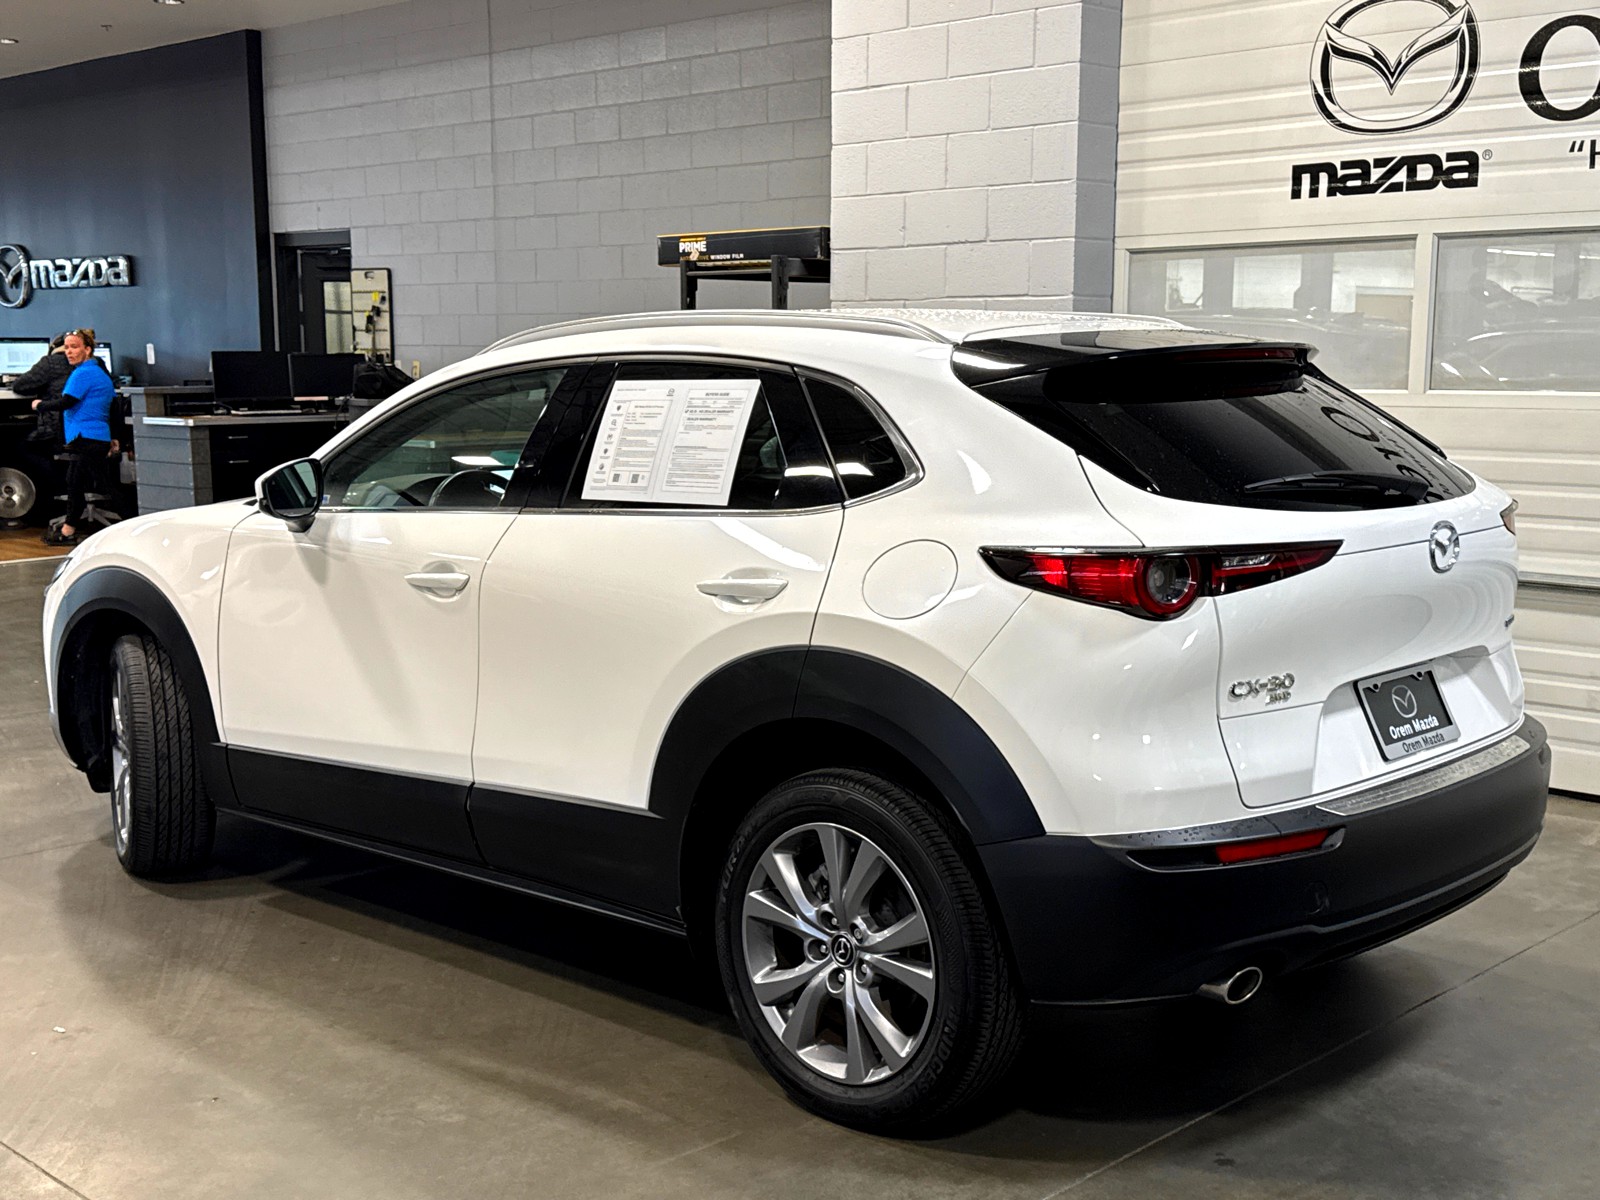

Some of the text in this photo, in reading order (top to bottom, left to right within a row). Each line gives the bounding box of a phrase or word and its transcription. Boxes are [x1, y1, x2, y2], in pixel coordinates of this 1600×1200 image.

[679, 241, 707, 253] PRIME
[1389, 714, 1440, 740] Orem Mazda
[1402, 732, 1445, 753] Orem Mazda
